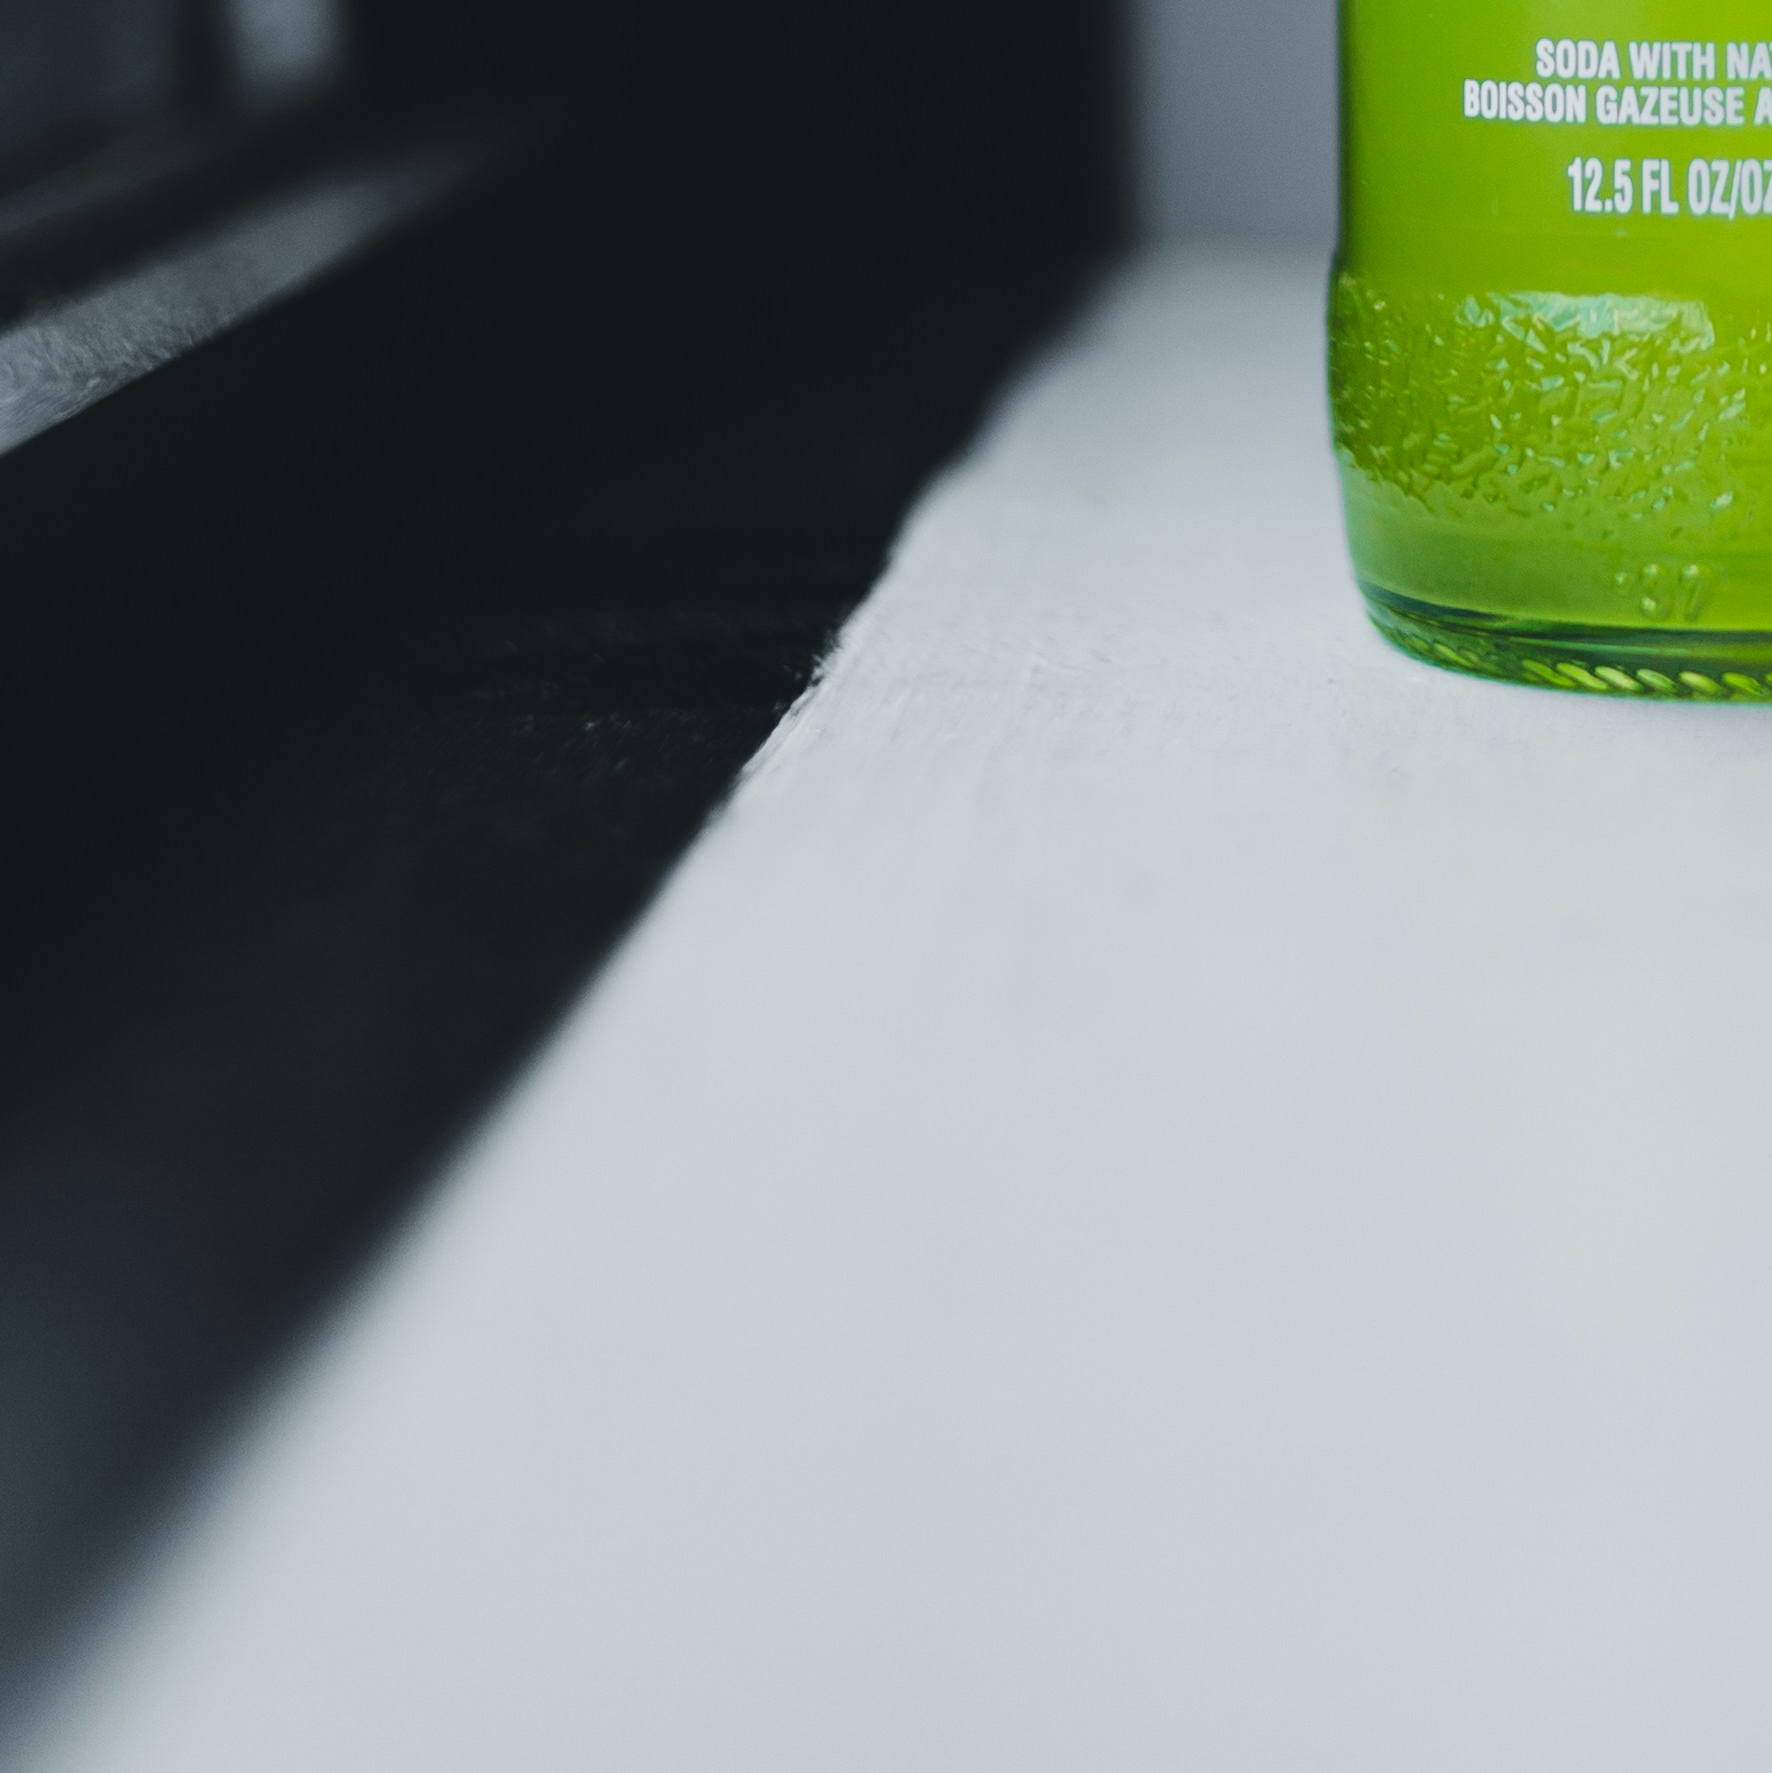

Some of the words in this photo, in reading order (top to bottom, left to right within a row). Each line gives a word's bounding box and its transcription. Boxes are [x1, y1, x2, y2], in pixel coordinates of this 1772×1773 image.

[1535, 38, 1622, 79] SODA
[1628, 40, 1717, 80] WITH
[1463, 79, 1586, 123] BOISSON
[1595, 87, 1746, 126] GAZEUSE
[1566, 157, 1634, 215] 12.5
[1641, 158, 1680, 215] FL
